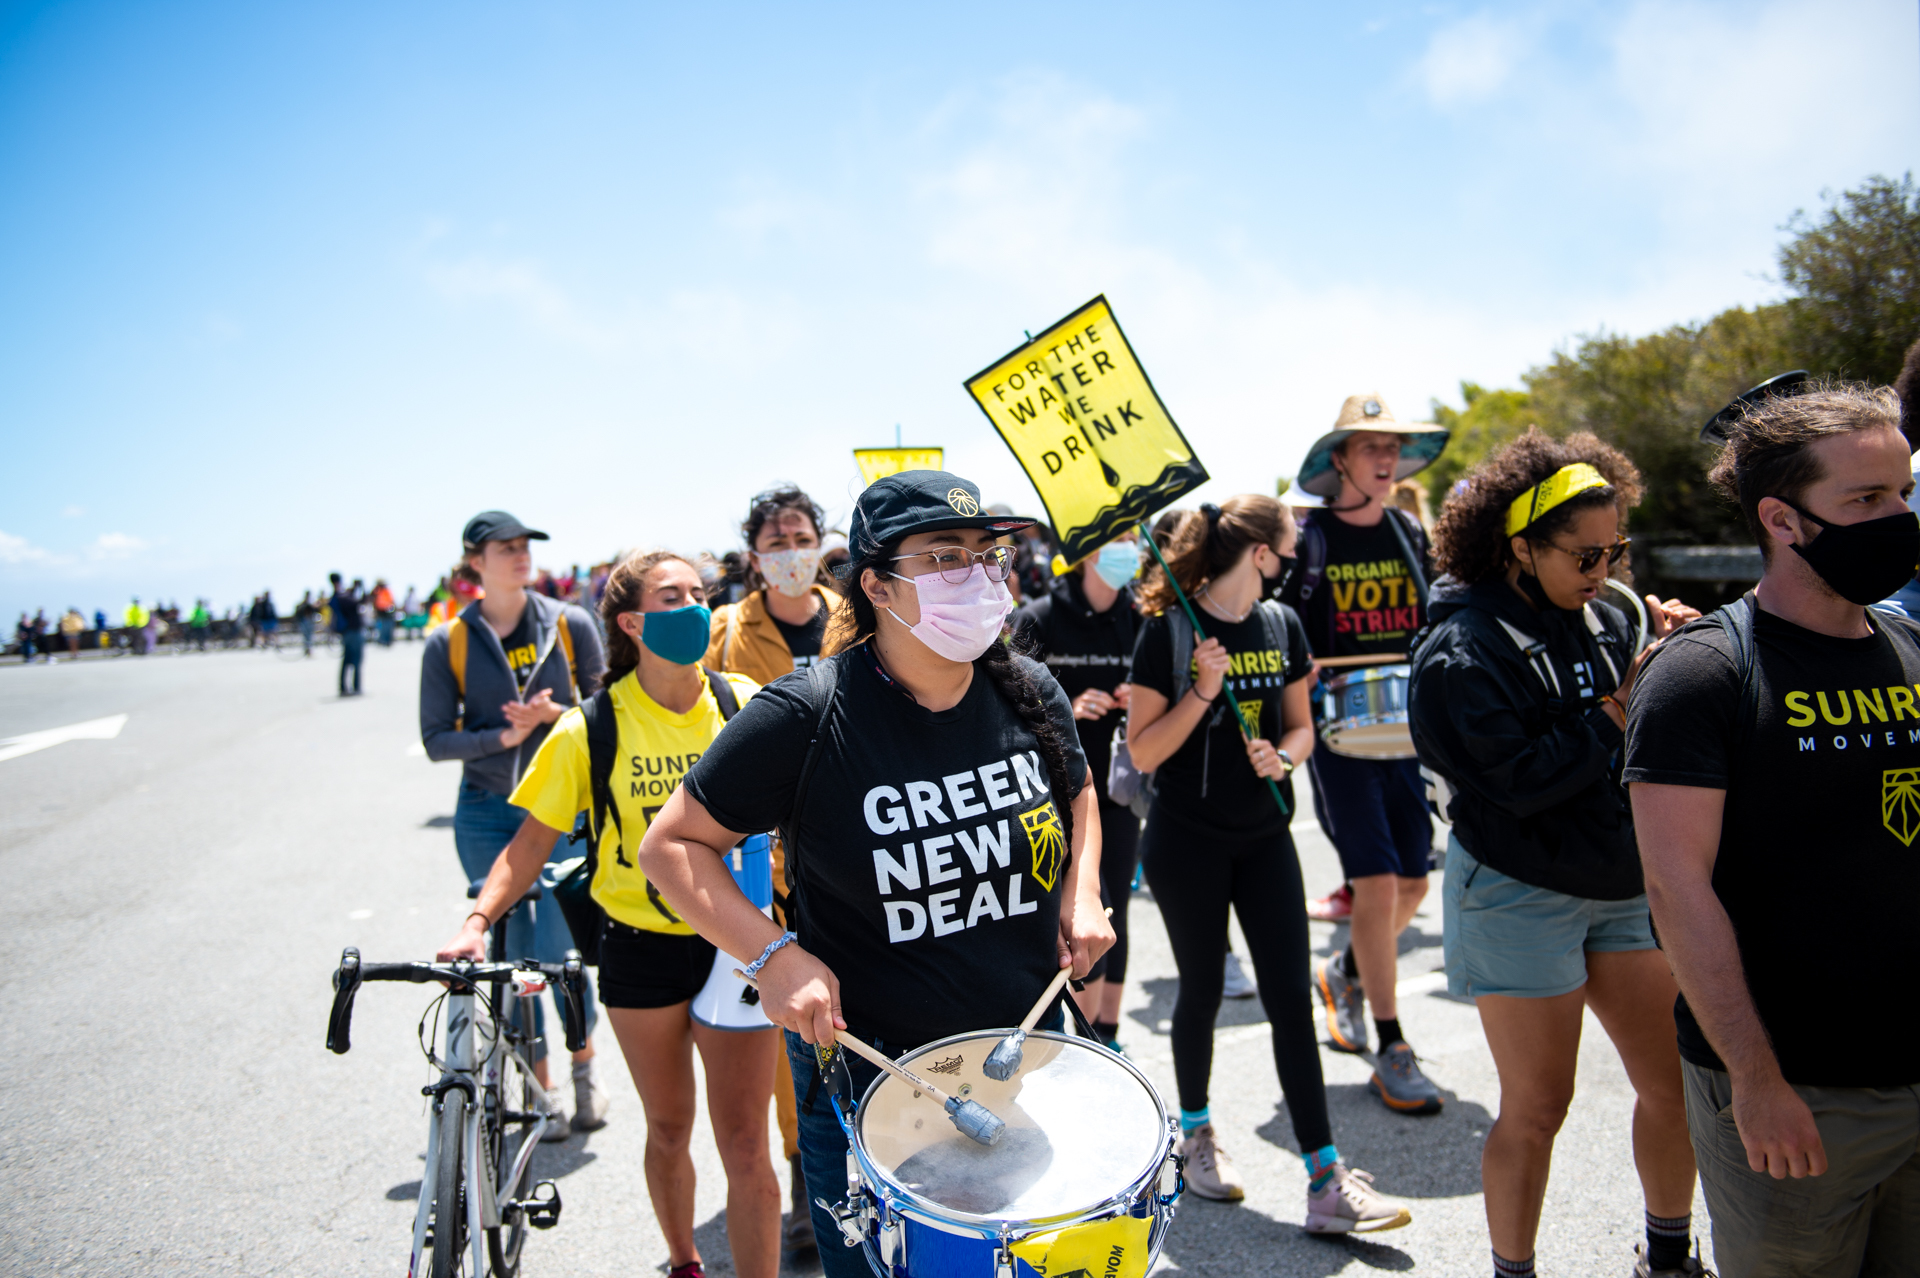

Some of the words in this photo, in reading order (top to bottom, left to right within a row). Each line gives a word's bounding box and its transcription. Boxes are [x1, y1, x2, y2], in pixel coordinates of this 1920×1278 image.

[992, 360, 1043, 402] FOR
[1048, 324, 1101, 363] THE
[1008, 350, 1116, 425] WATER
[1041, 399, 1144, 476] DRINK
[1058, 396, 1093, 425] WE
[630, 777, 683, 798] MOV
[863, 750, 1049, 836] GREEN
[872, 819, 1011, 895] NEW
[882, 872, 1038, 944] DEAL
